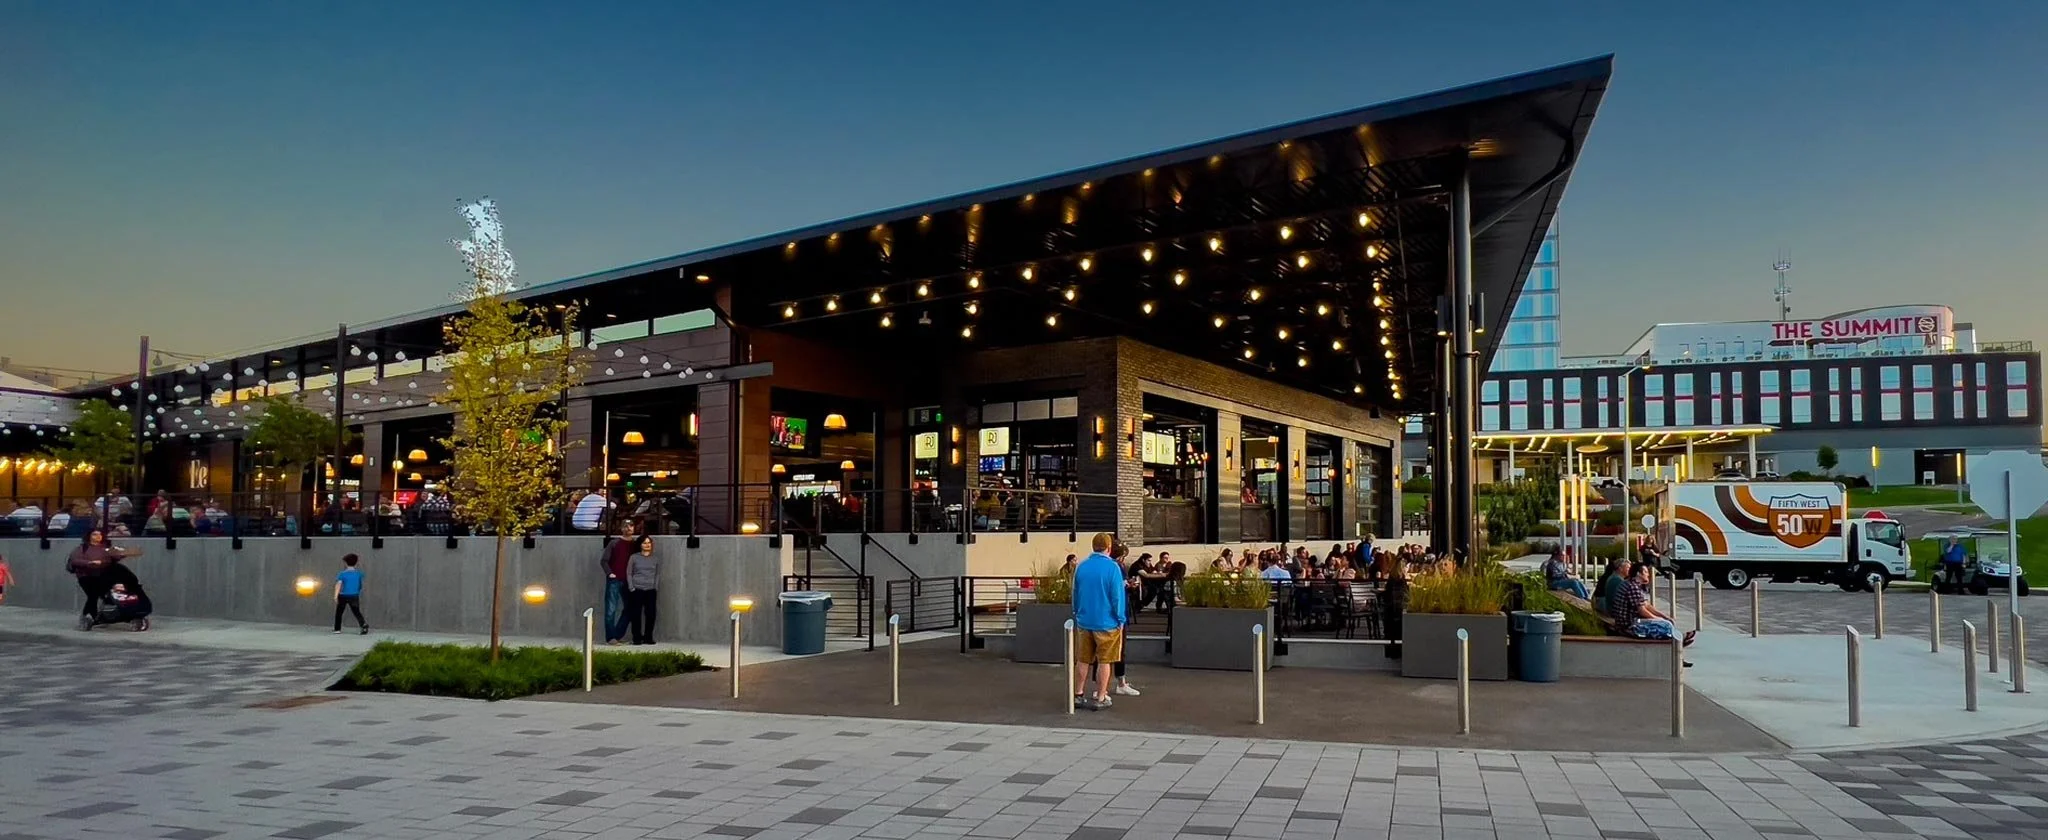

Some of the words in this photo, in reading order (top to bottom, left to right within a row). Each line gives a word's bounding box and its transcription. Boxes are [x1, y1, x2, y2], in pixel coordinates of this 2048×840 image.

[1772, 322, 1813, 339] THE
[1820, 317, 1913, 337] SUMMIT
[1778, 500, 1798, 508] FIFTY
[1799, 500, 1820, 508] WEST
